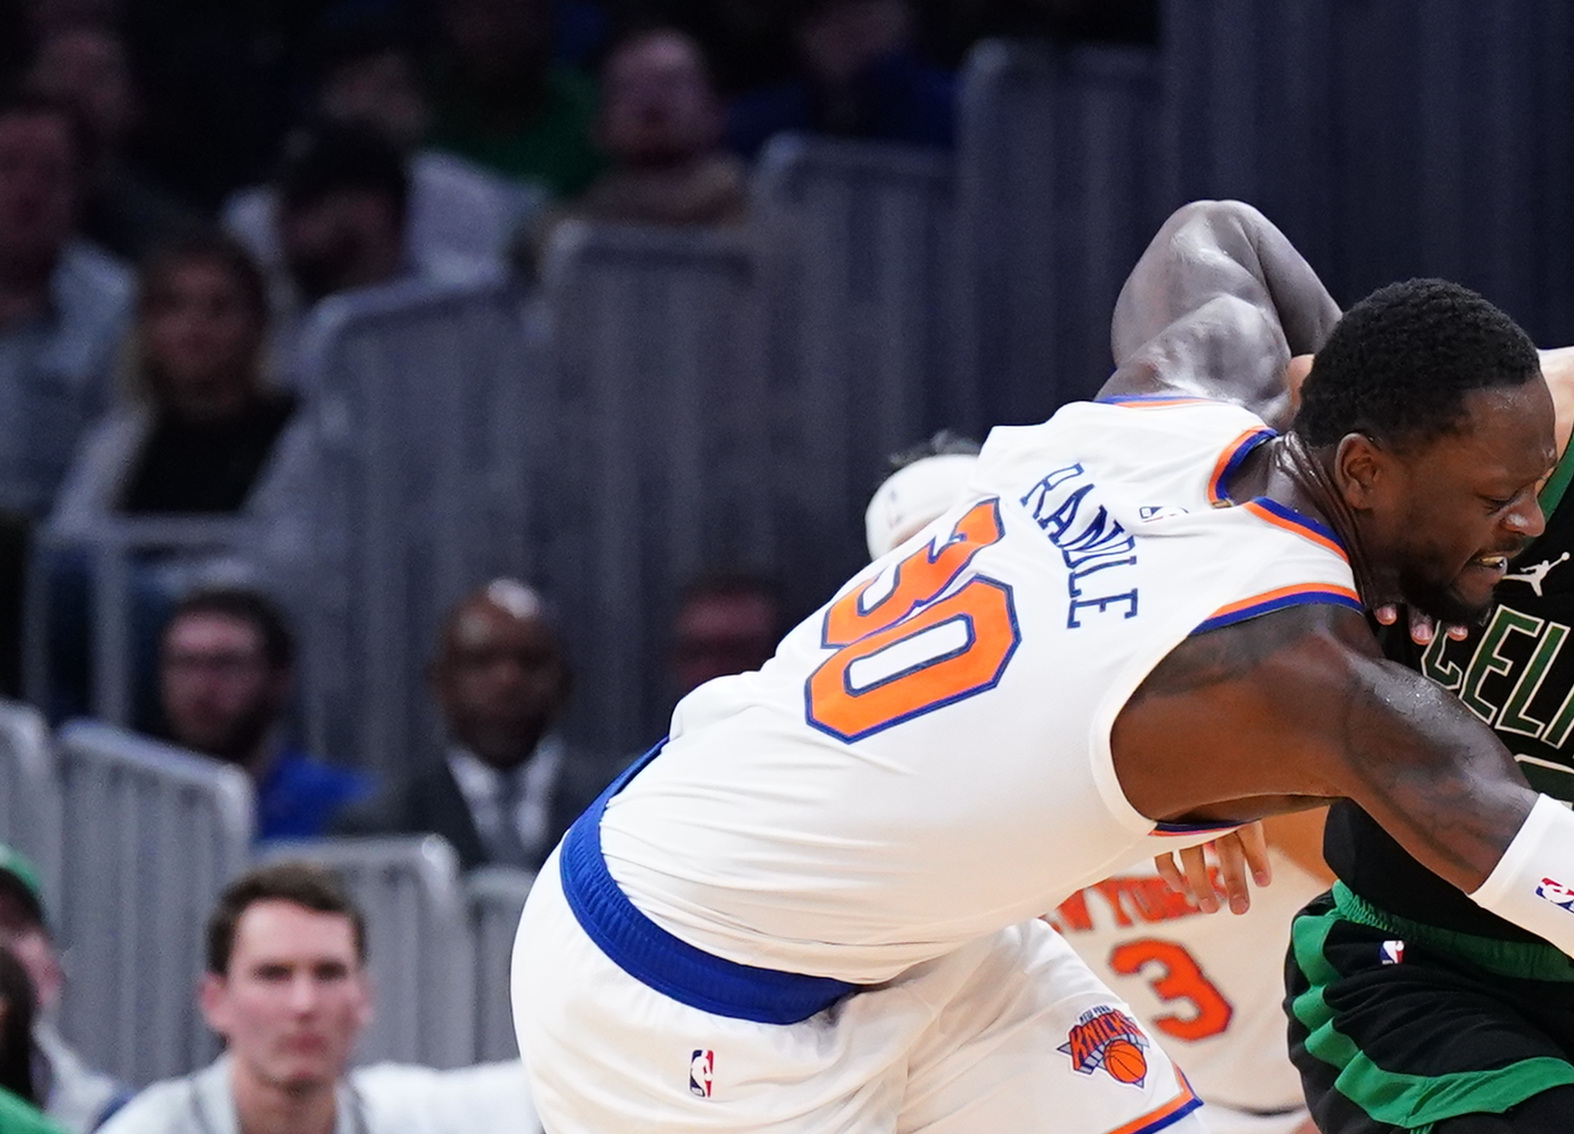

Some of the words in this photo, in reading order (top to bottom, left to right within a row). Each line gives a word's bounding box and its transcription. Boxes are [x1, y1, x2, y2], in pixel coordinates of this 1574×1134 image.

[804, 496, 1023, 746] 30
[1069, 1007, 1148, 1071] KNICKS
[1109, 936, 1234, 1043] 3
